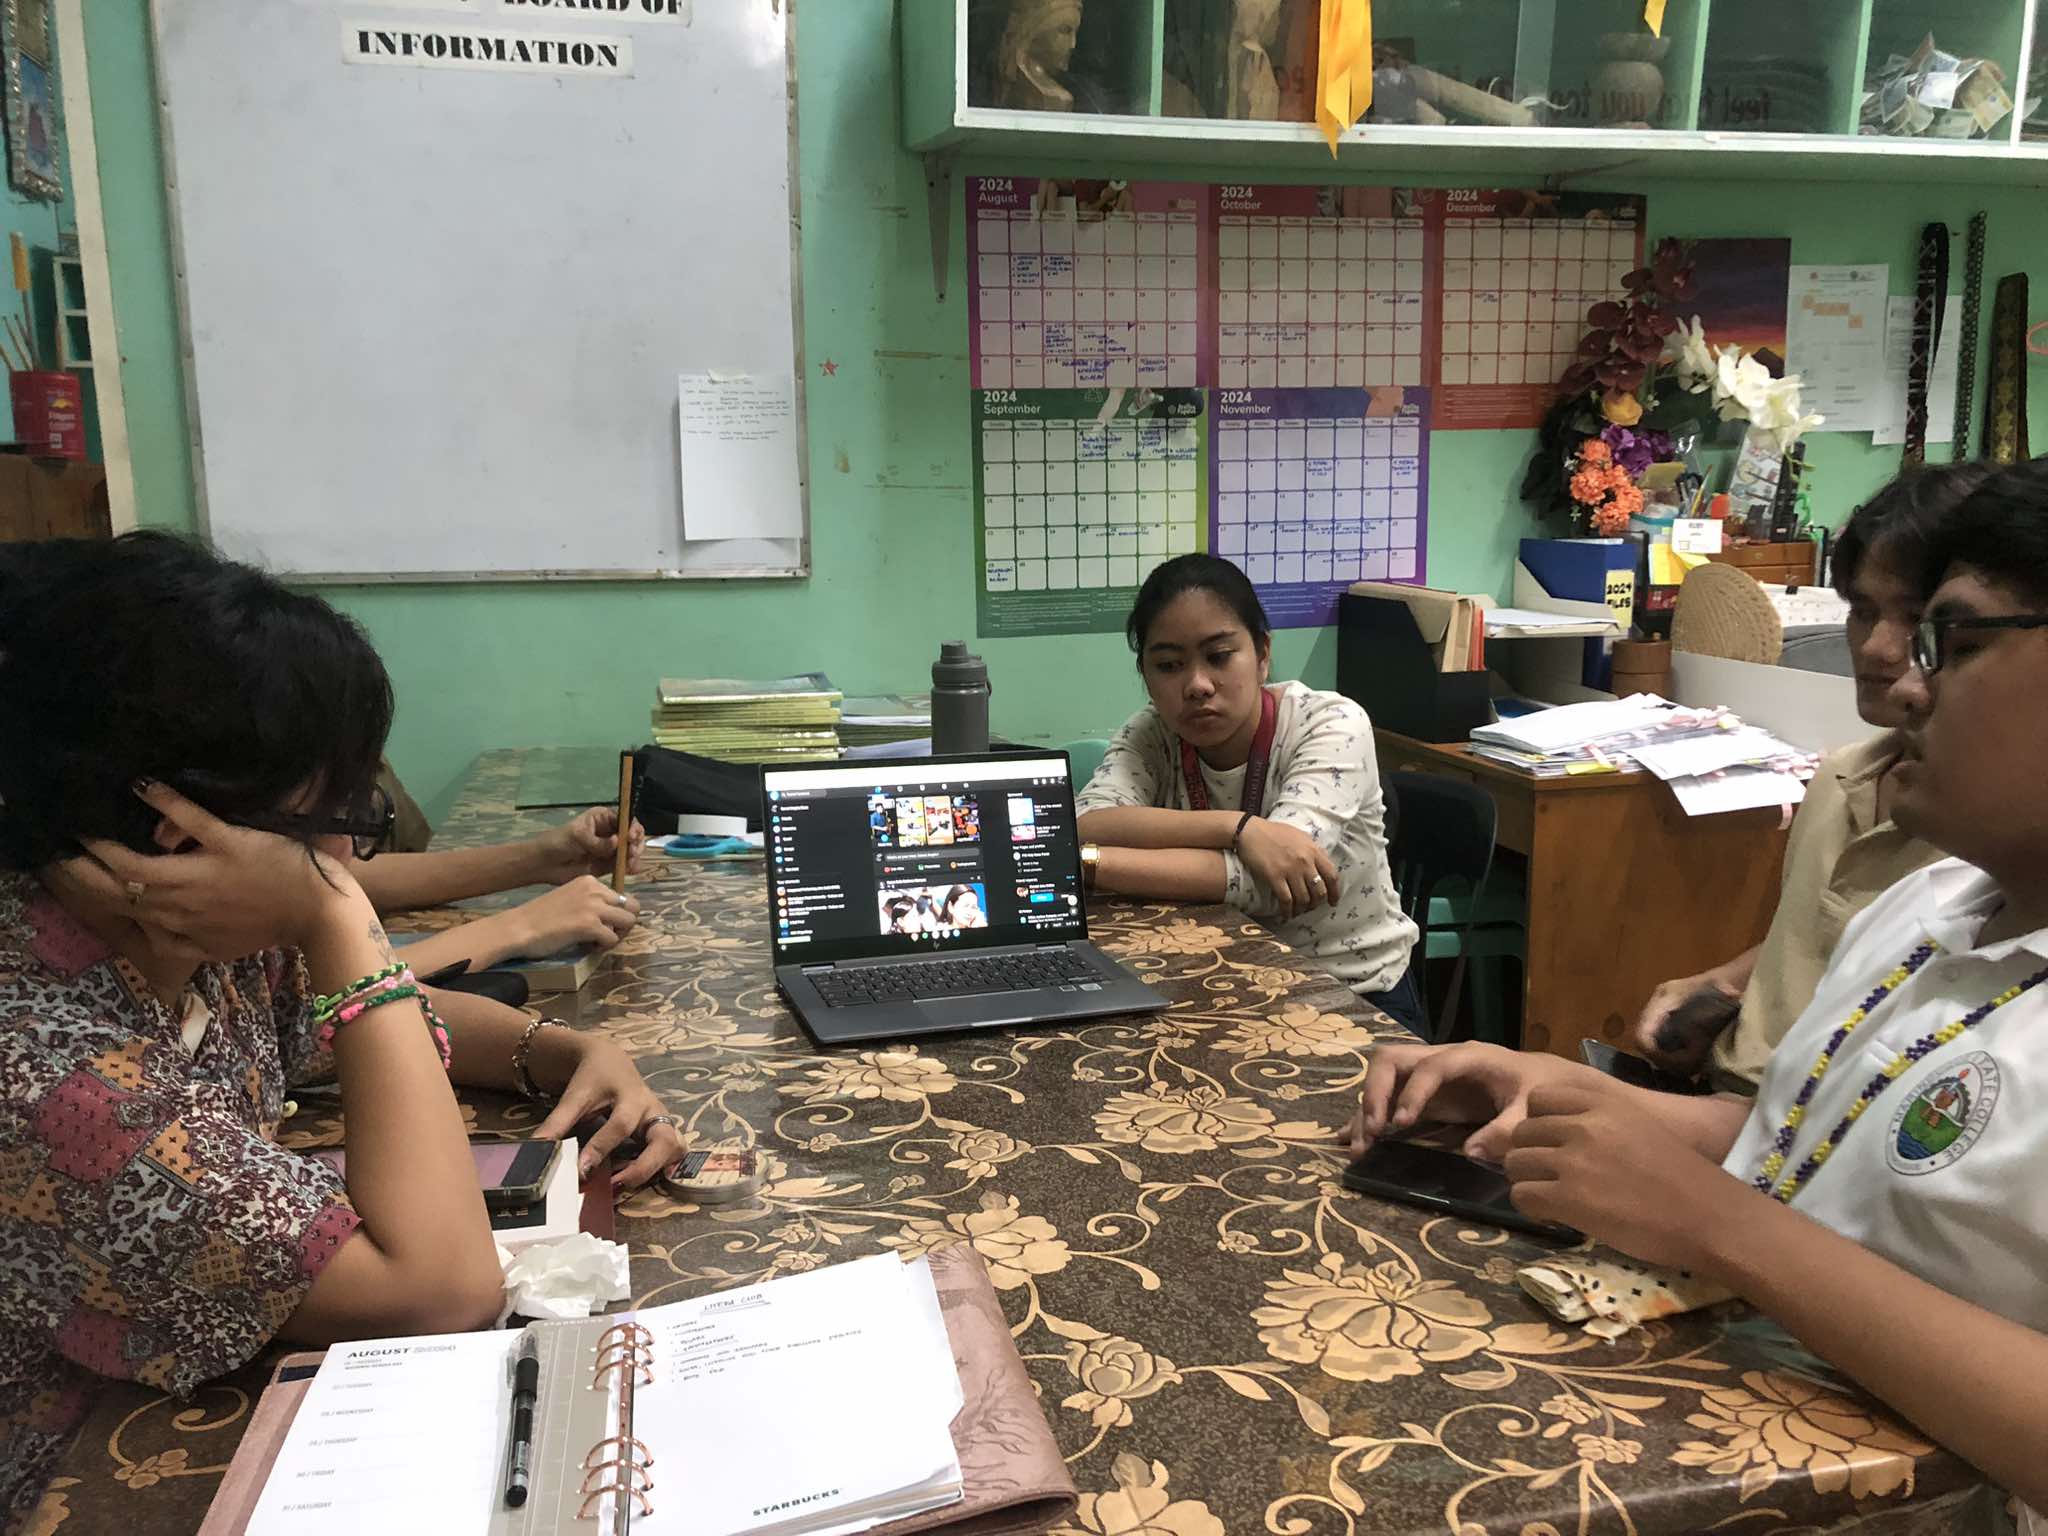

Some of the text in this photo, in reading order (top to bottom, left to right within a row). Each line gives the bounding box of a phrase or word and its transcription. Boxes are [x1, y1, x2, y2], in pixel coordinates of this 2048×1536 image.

[641, 0, 683, 14] OF
[357, 29, 619, 68] INFORMATION
[978, 178, 1013, 191] 2024
[978, 192, 1018, 205] August
[1220, 186, 1254, 199] 2024
[1446, 188, 1479, 202] 2024
[1220, 199, 1262, 210] October
[1446, 202, 1497, 213] December
[983, 390, 1017, 403] 2024
[1220, 390, 1253, 404] 2024
[983, 404, 1041, 416] September
[1220, 404, 1272, 415] November
[1606, 583, 1632, 595] 2024
[1944, 1097, 1994, 1162] COLLEGE
[346, 1347, 411, 1359] AUGUST
[753, 1488, 840, 1517] STARBUCKS
